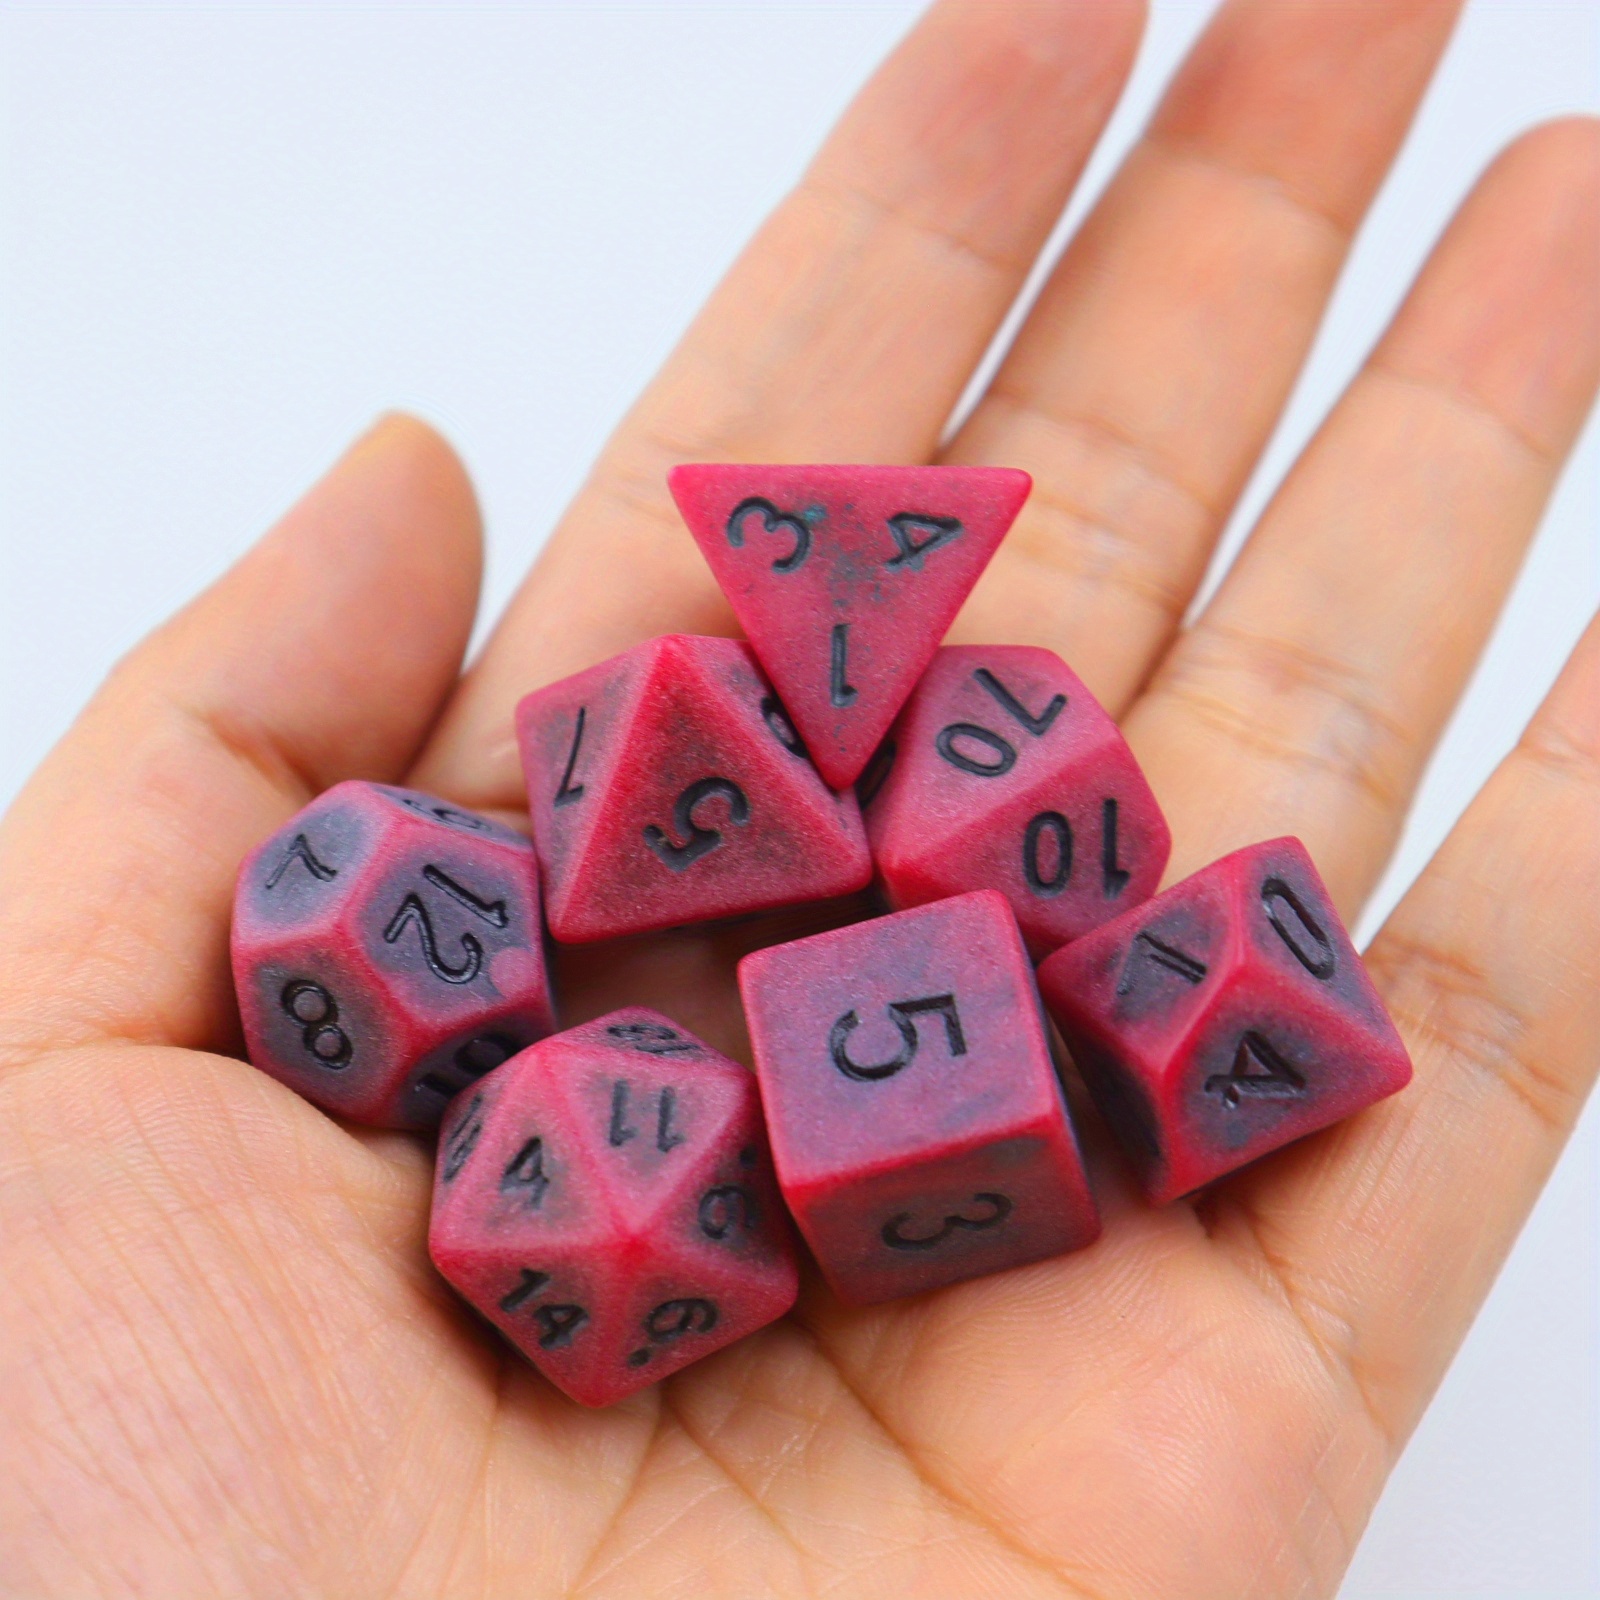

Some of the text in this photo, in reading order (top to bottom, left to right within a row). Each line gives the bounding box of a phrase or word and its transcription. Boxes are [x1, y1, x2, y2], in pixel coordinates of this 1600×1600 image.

[724, 496, 814, 575] 3
[885, 511, 966, 573] 4
[830, 623, 859, 708] 1
[935, 667, 1069, 778] 70
[643, 776, 752, 874] 5
[1022, 797, 1131, 900] 10
[383, 863, 509, 985] 12
[1261, 876, 1336, 981] 0
[281, 978, 353, 1071] 8
[829, 993, 969, 1082] 5
[1204, 1029, 1307, 1110] 4
[609, 1079, 685, 1154] 11
[499, 1134, 550, 1210] 4
[881, 1191, 1013, 1252] 3
[501, 1267, 591, 1351] 14
